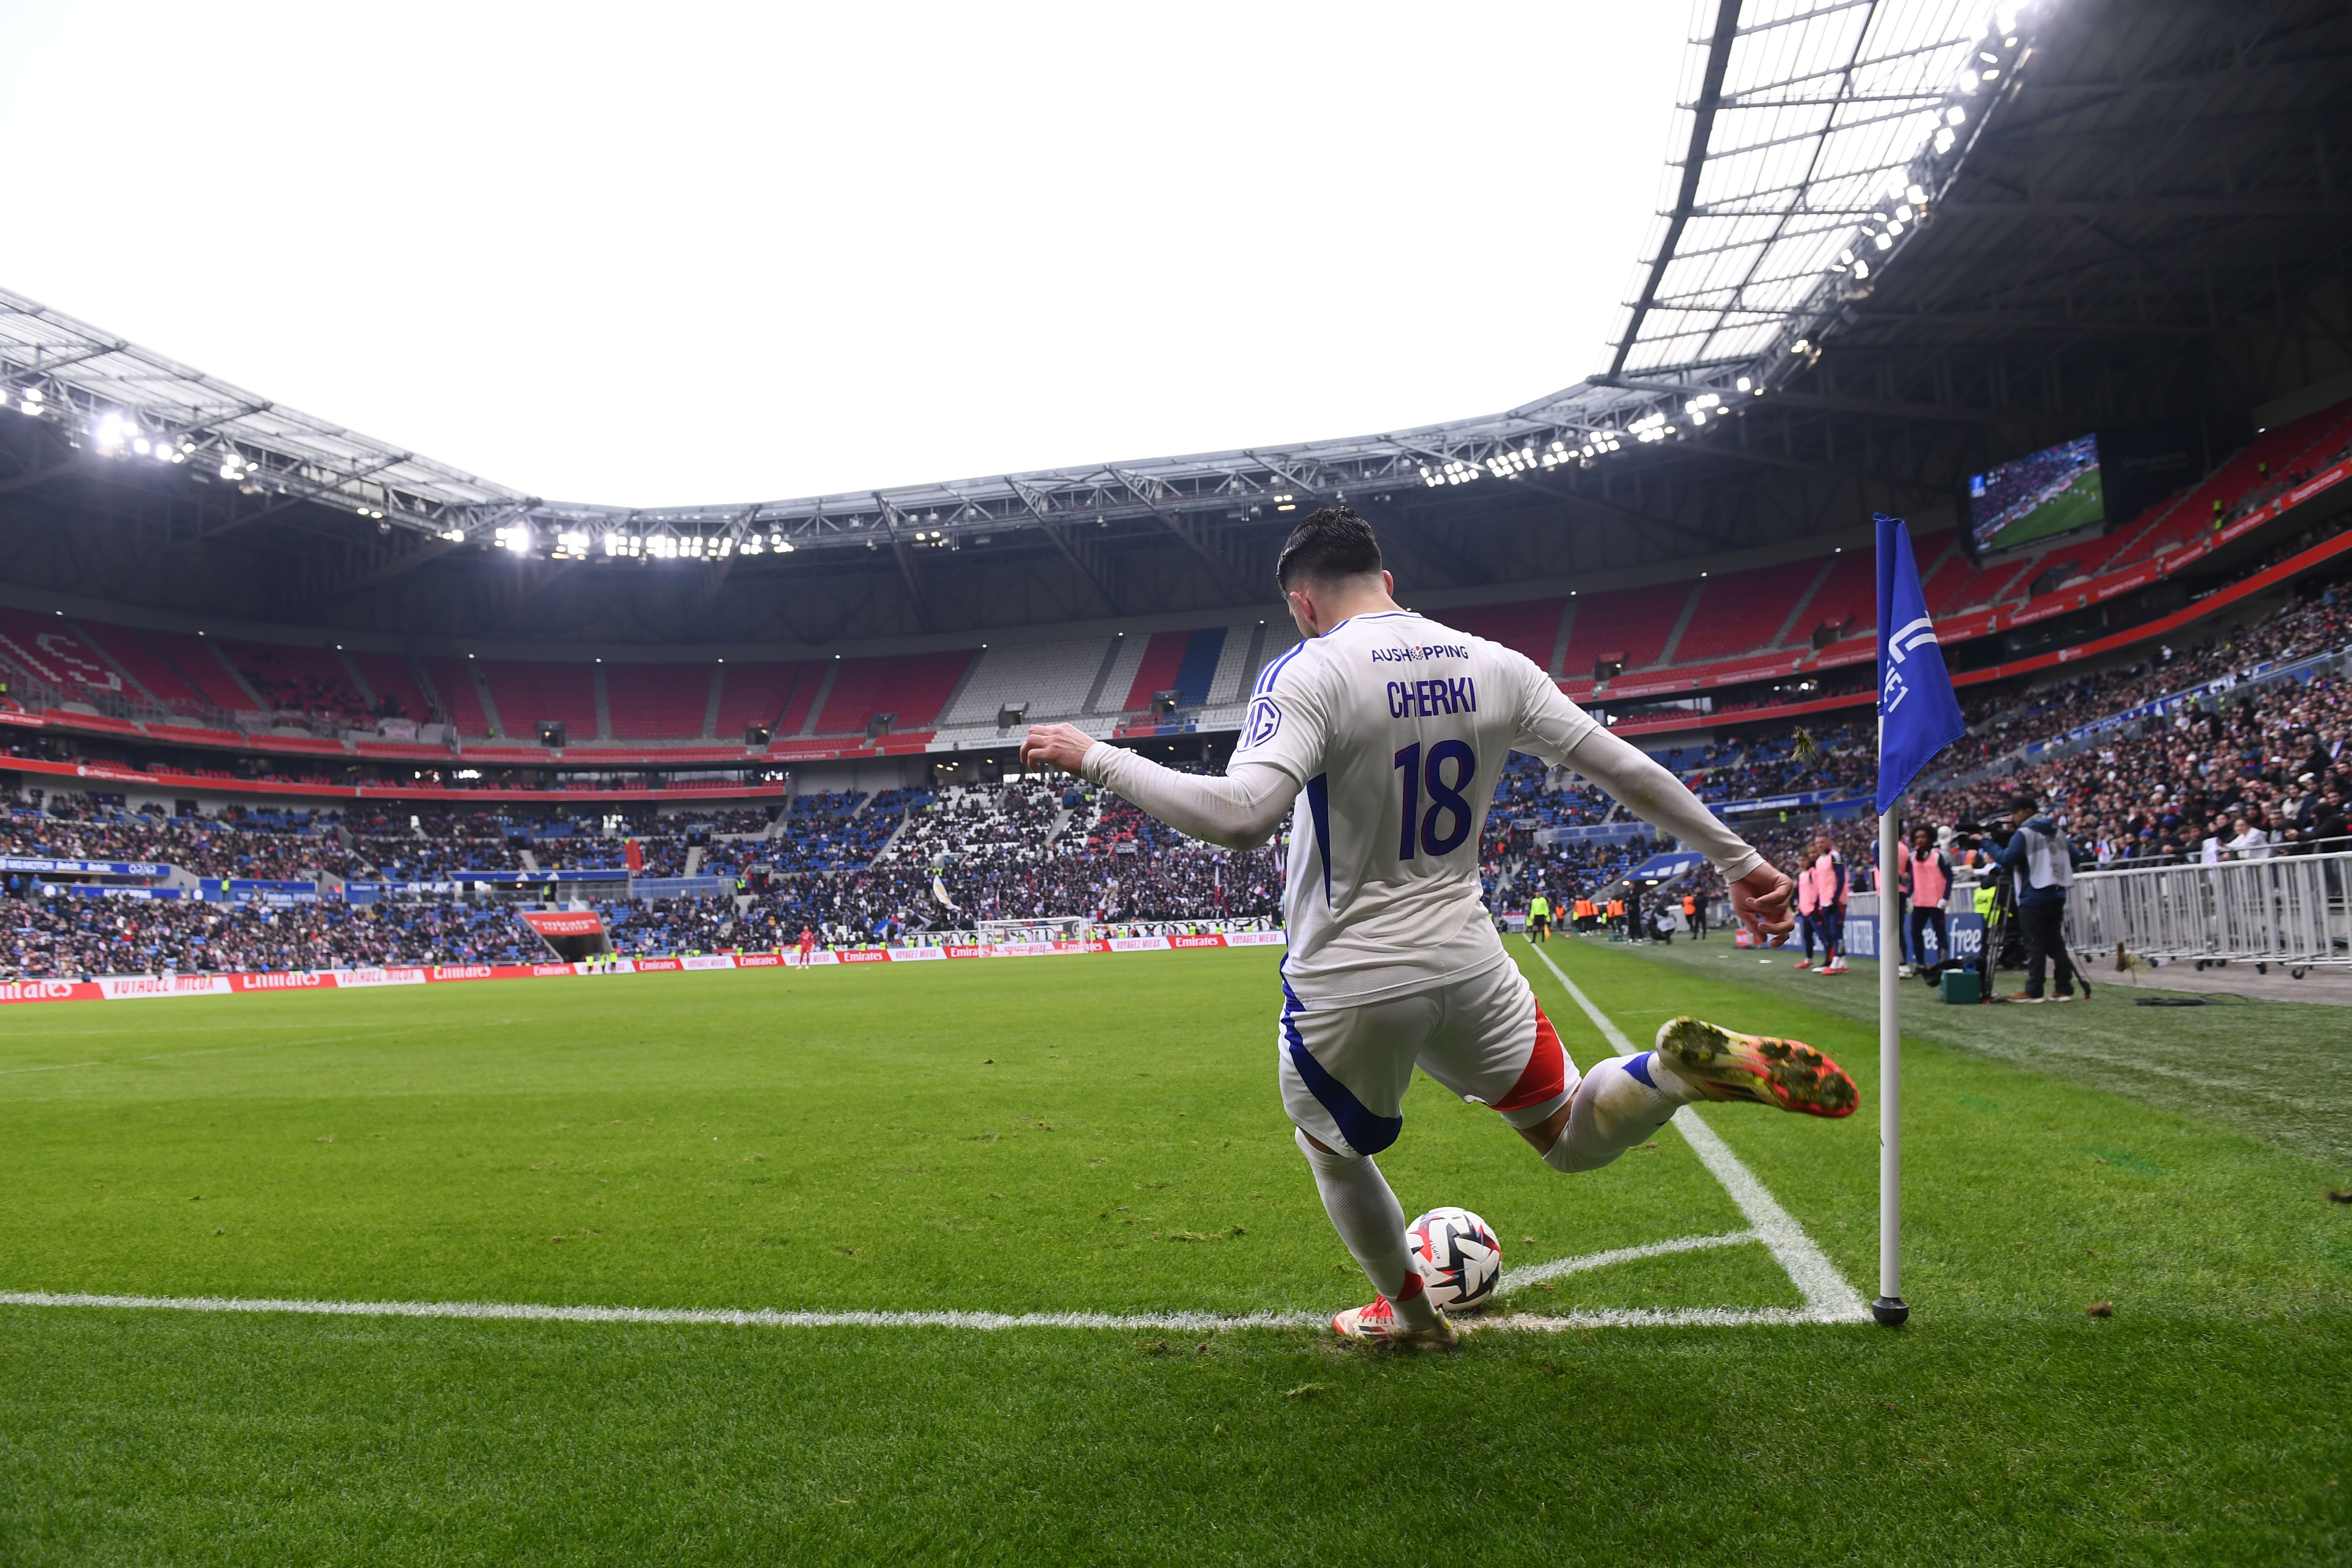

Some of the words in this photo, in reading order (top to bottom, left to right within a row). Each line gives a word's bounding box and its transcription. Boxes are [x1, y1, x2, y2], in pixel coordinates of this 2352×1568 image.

[1387, 677, 1476, 718] CHERKI
[1238, 702, 1276, 749] MG
[1395, 740, 1475, 860] 18
[1176, 936, 1218, 947] Emirates
[1233, 935, 1257, 943] VOYAGEZ
[1259, 934, 1277, 942] MIEUX
[1950, 917, 1982, 959] free
[1117, 940, 1140, 949] VOYAGEZ
[1143, 939, 1160, 947] MIEUX
[739, 956, 778, 966] Emirates
[844, 952, 883, 962] Emirates
[533, 965, 571, 976] Emirates
[639, 960, 677, 971] Emirates
[1429, 1239, 1441, 1260] KIPSTA
